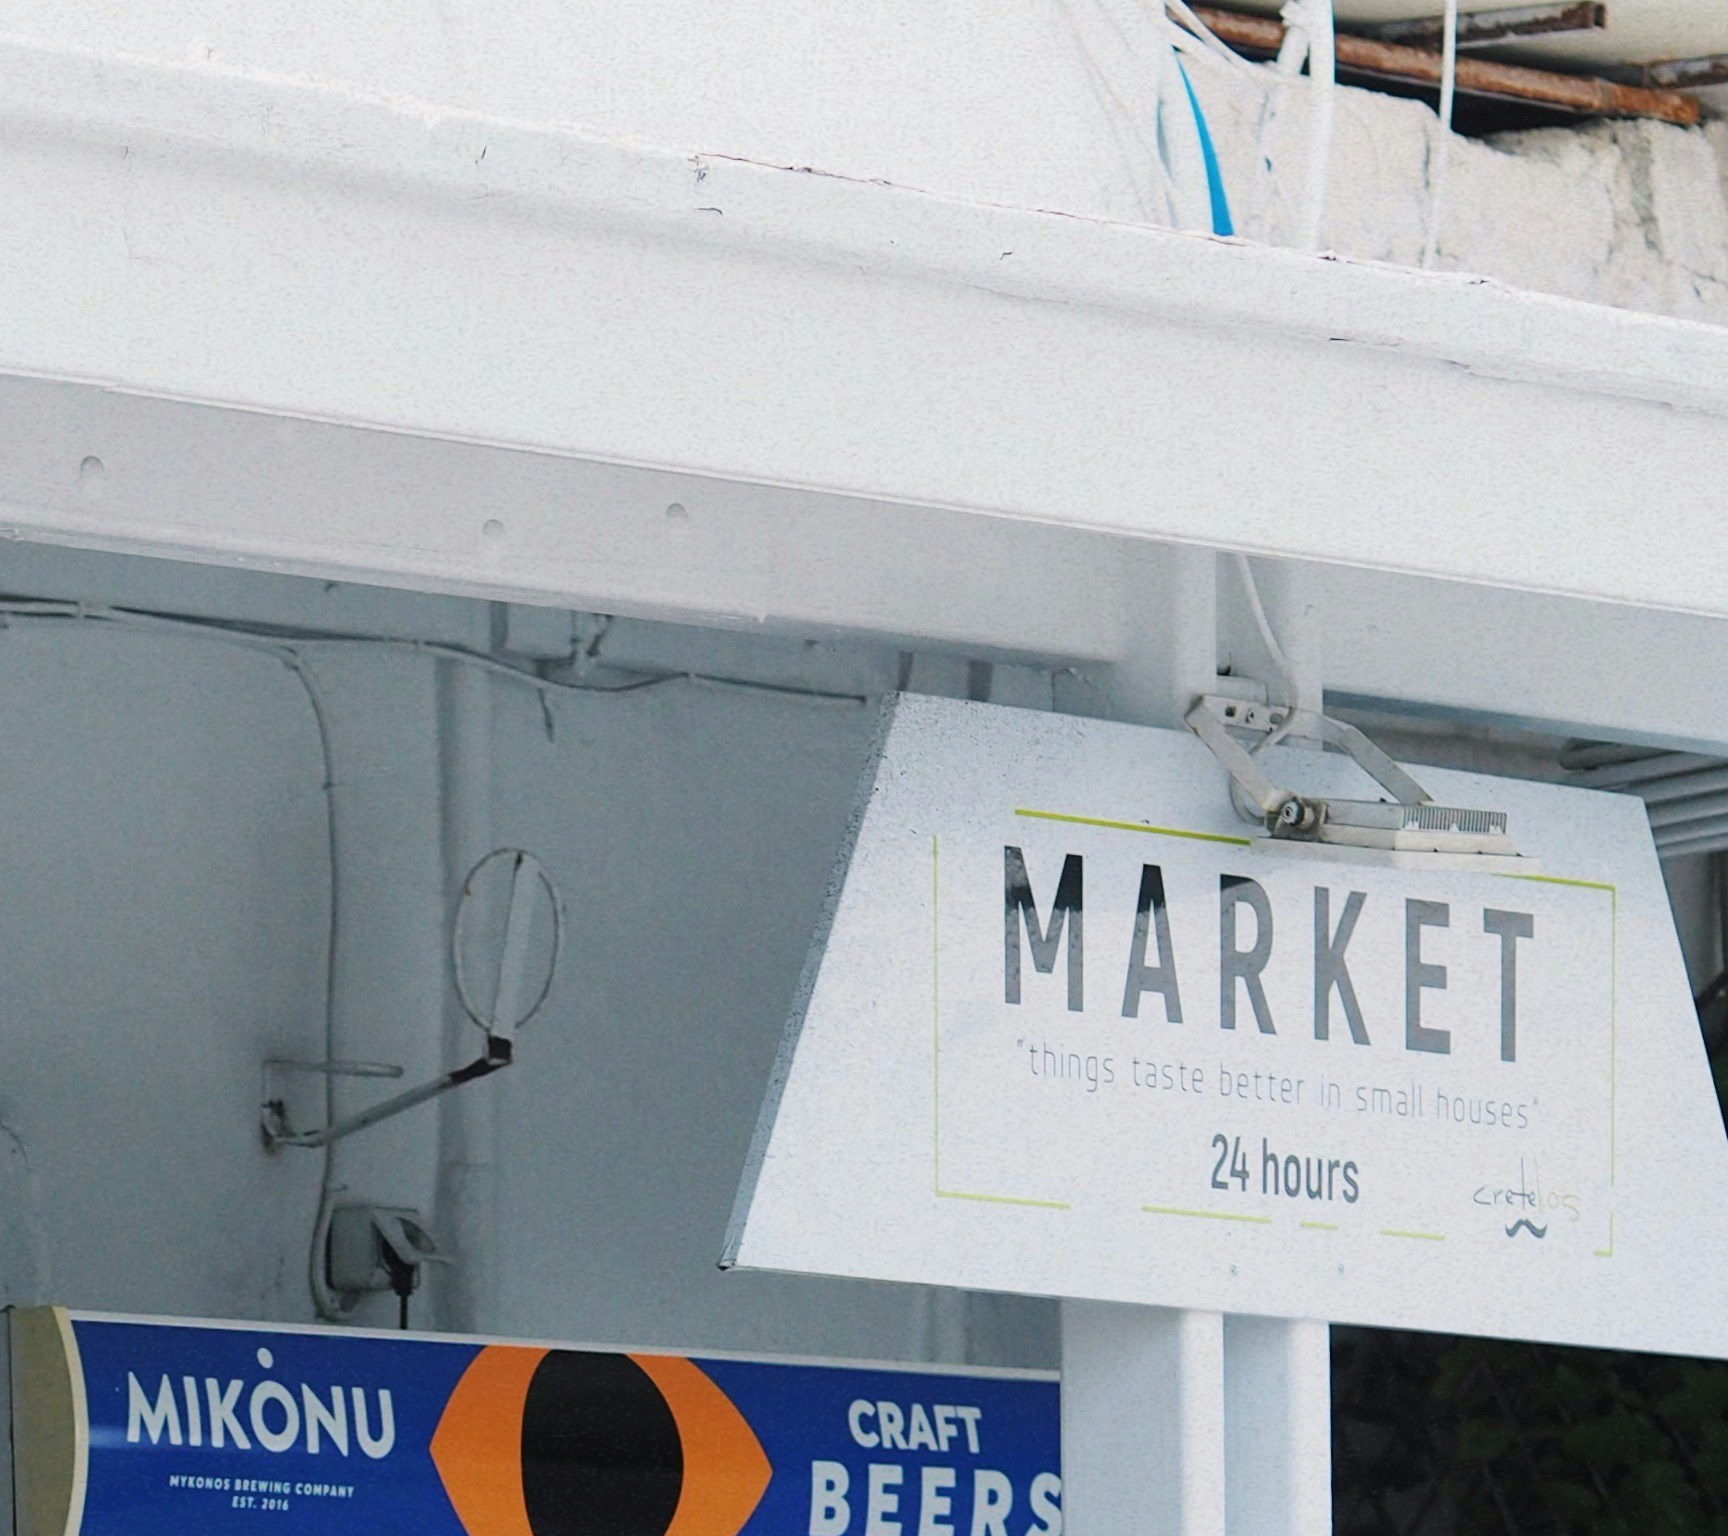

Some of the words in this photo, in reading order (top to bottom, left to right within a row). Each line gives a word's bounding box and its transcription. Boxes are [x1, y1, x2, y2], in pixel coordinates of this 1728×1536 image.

[1004, 845, 1534, 1062] MARKET
[1132, 1054, 1204, 1094] taste
[1220, 1061, 1304, 1106] better
[1320, 1073, 1342, 1107] in
[1356, 1078, 1425, 1118] small
[1211, 1134, 1250, 1191] 24
[1262, 1137, 1360, 1203] hours
[848, 1399, 981, 1454] CRAFT
[170, 1475, 230, 1491] MYKONOS
[235, 1479, 291, 1494] BREWING
[295, 1483, 354, 1498] COMPANY
[232, 1496, 257, 1509] EST.
[262, 1498, 289, 1511] 2016
